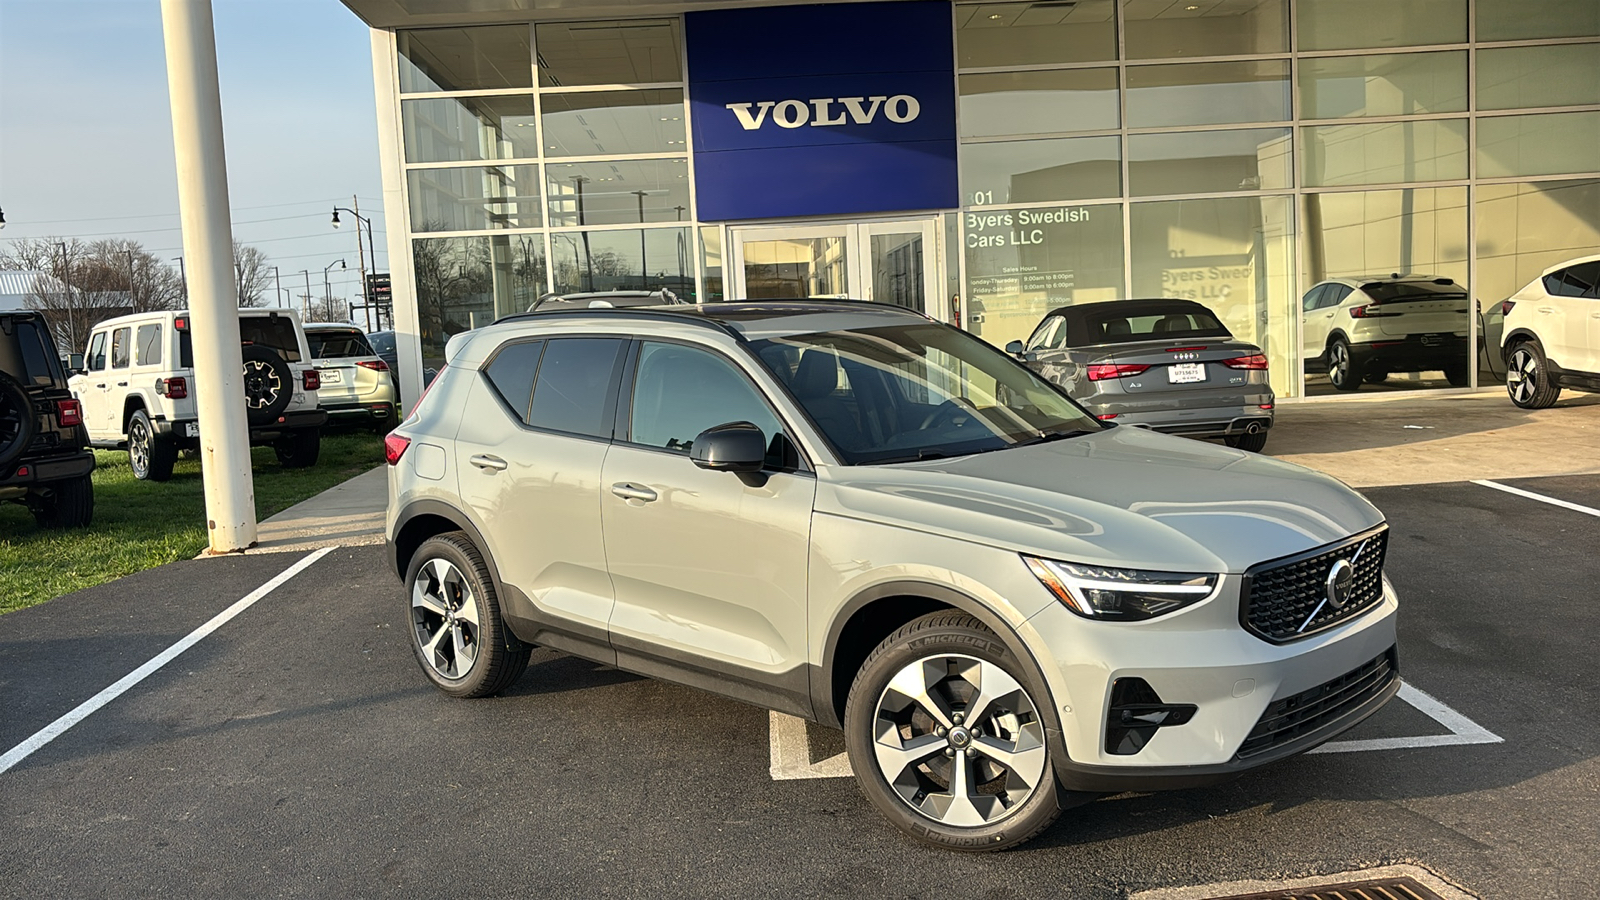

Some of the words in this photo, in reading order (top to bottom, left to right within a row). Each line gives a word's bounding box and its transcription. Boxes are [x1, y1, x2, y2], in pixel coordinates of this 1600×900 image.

[726, 94, 920, 130] VOLVO
[967, 213, 1013, 231] Byers
[1018, 207, 1090, 225] Swedish
[967, 233, 1005, 248] Cars
[1010, 229, 1043, 245] LLC
[924, 634, 986, 649] MICHELIN
